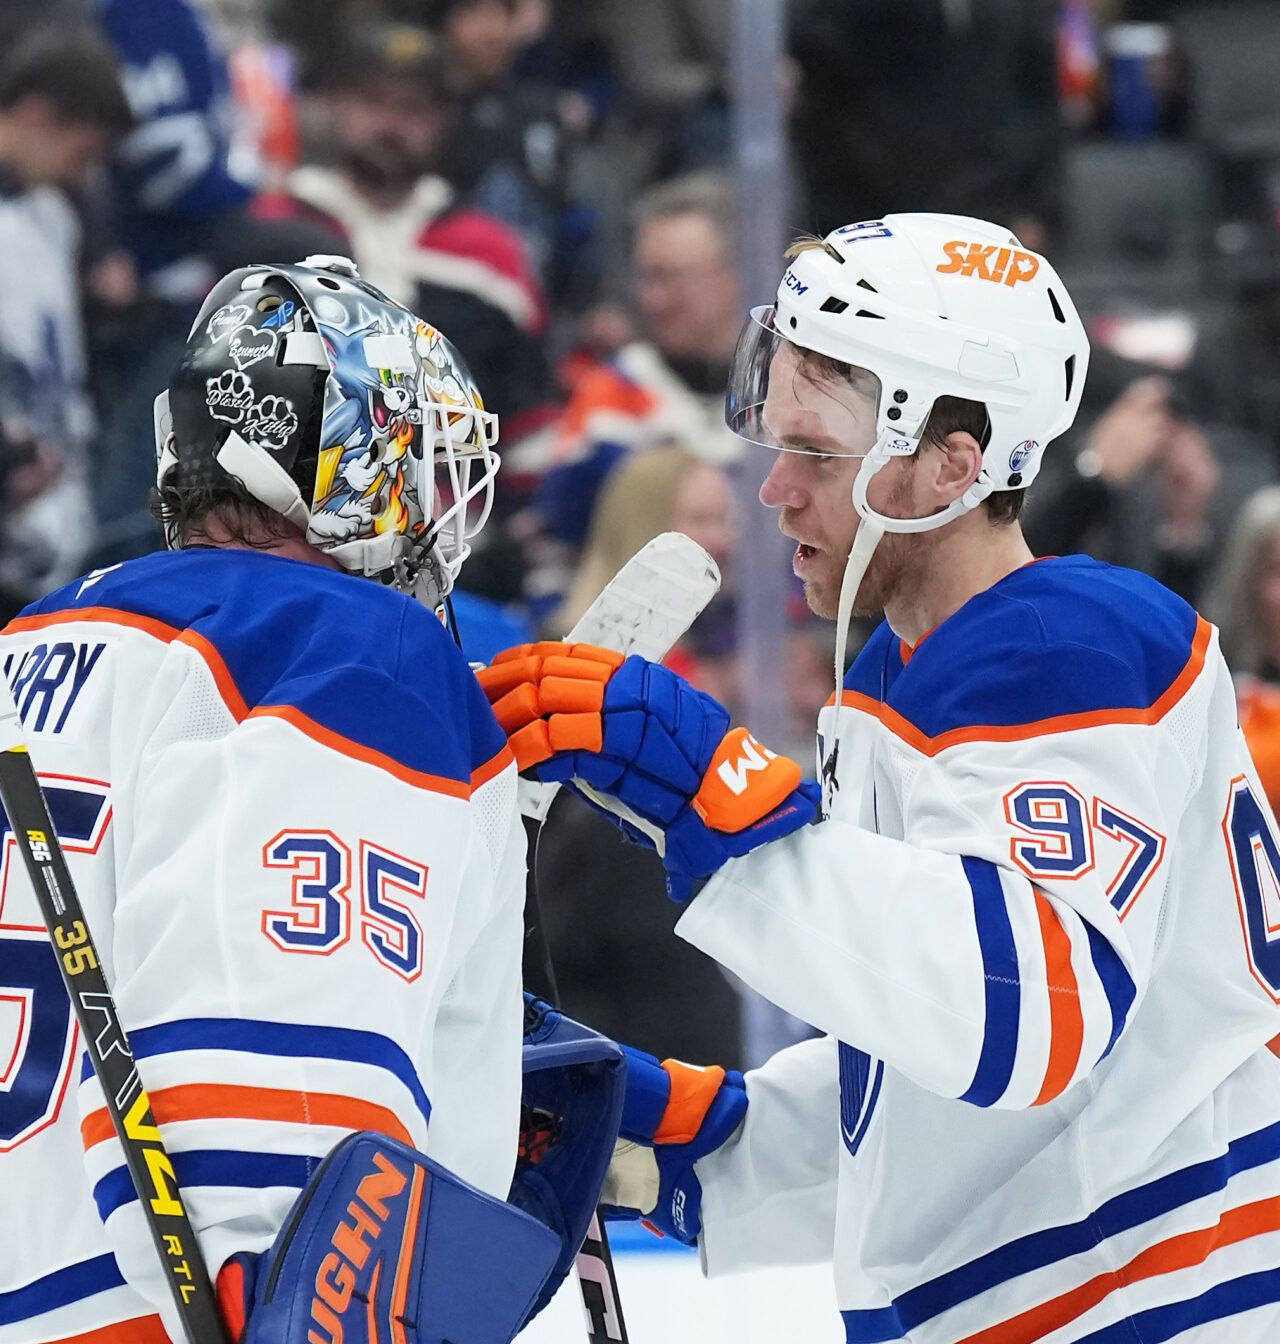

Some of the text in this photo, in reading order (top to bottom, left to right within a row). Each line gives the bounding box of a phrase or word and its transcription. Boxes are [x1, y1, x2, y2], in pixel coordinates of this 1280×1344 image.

[935, 240, 1040, 288] SKIP
[229, 338, 274, 358] Bennett
[206, 390, 253, 409] Diesel
[1002, 780, 1167, 924] 97
[261, 828, 429, 984] 35
[53, 919, 98, 976] 35
[162, 1234, 198, 1305] RTL
